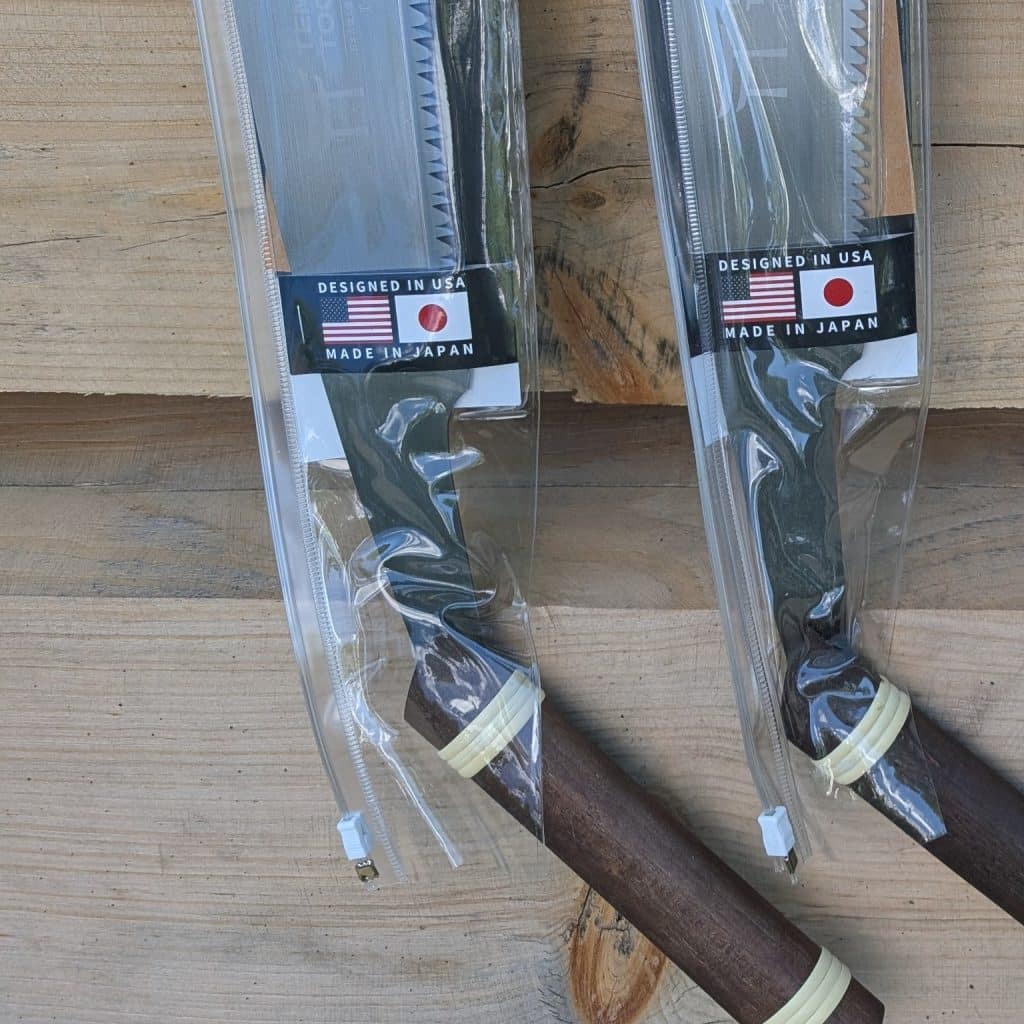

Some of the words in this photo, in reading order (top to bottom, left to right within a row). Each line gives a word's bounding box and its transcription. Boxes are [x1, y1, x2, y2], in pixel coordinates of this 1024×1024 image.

[719, 255, 805, 271] DESIGNED
[814, 254, 831, 265] IN
[839, 250, 873, 263] USA
[318, 280, 400, 294] DESIGNED
[408, 280, 425, 291] IN
[432, 278, 466, 290] USA
[725, 325, 775, 338] MADE
[786, 324, 805, 335] IN
[816, 317, 878, 334] JAPAN
[326, 348, 374, 360] MADE
[384, 347, 402, 358] IN
[413, 343, 474, 357] JAPAN
